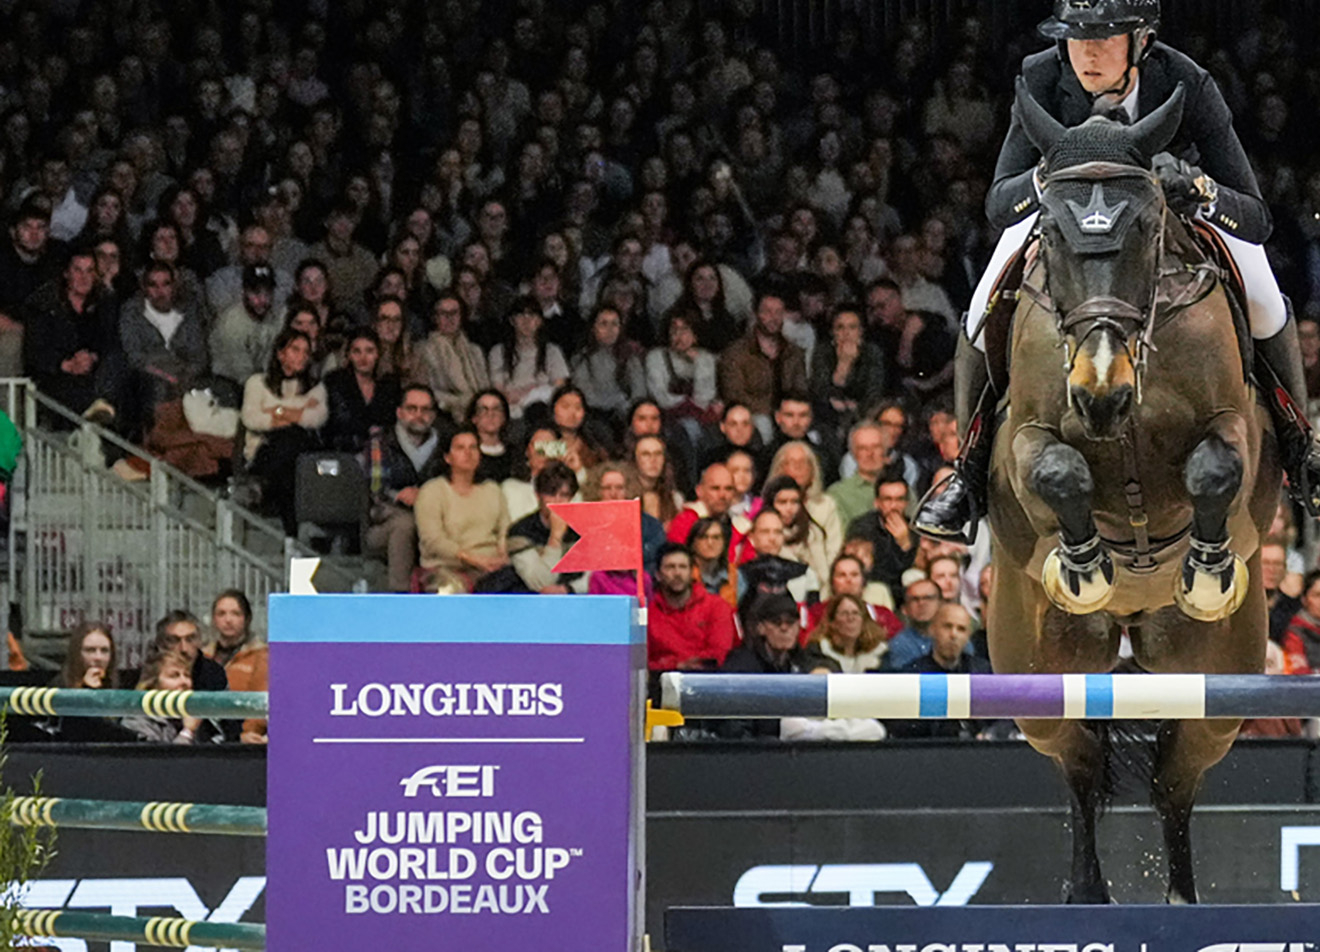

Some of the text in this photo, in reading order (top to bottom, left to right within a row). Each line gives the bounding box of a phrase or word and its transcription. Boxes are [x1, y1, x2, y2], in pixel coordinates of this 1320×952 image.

[330, 682, 564, 717] LONGINES
[354, 811, 543, 844] JUMPING
[326, 847, 477, 880] WORLD
[345, 884, 550, 914] BORDEAUX
